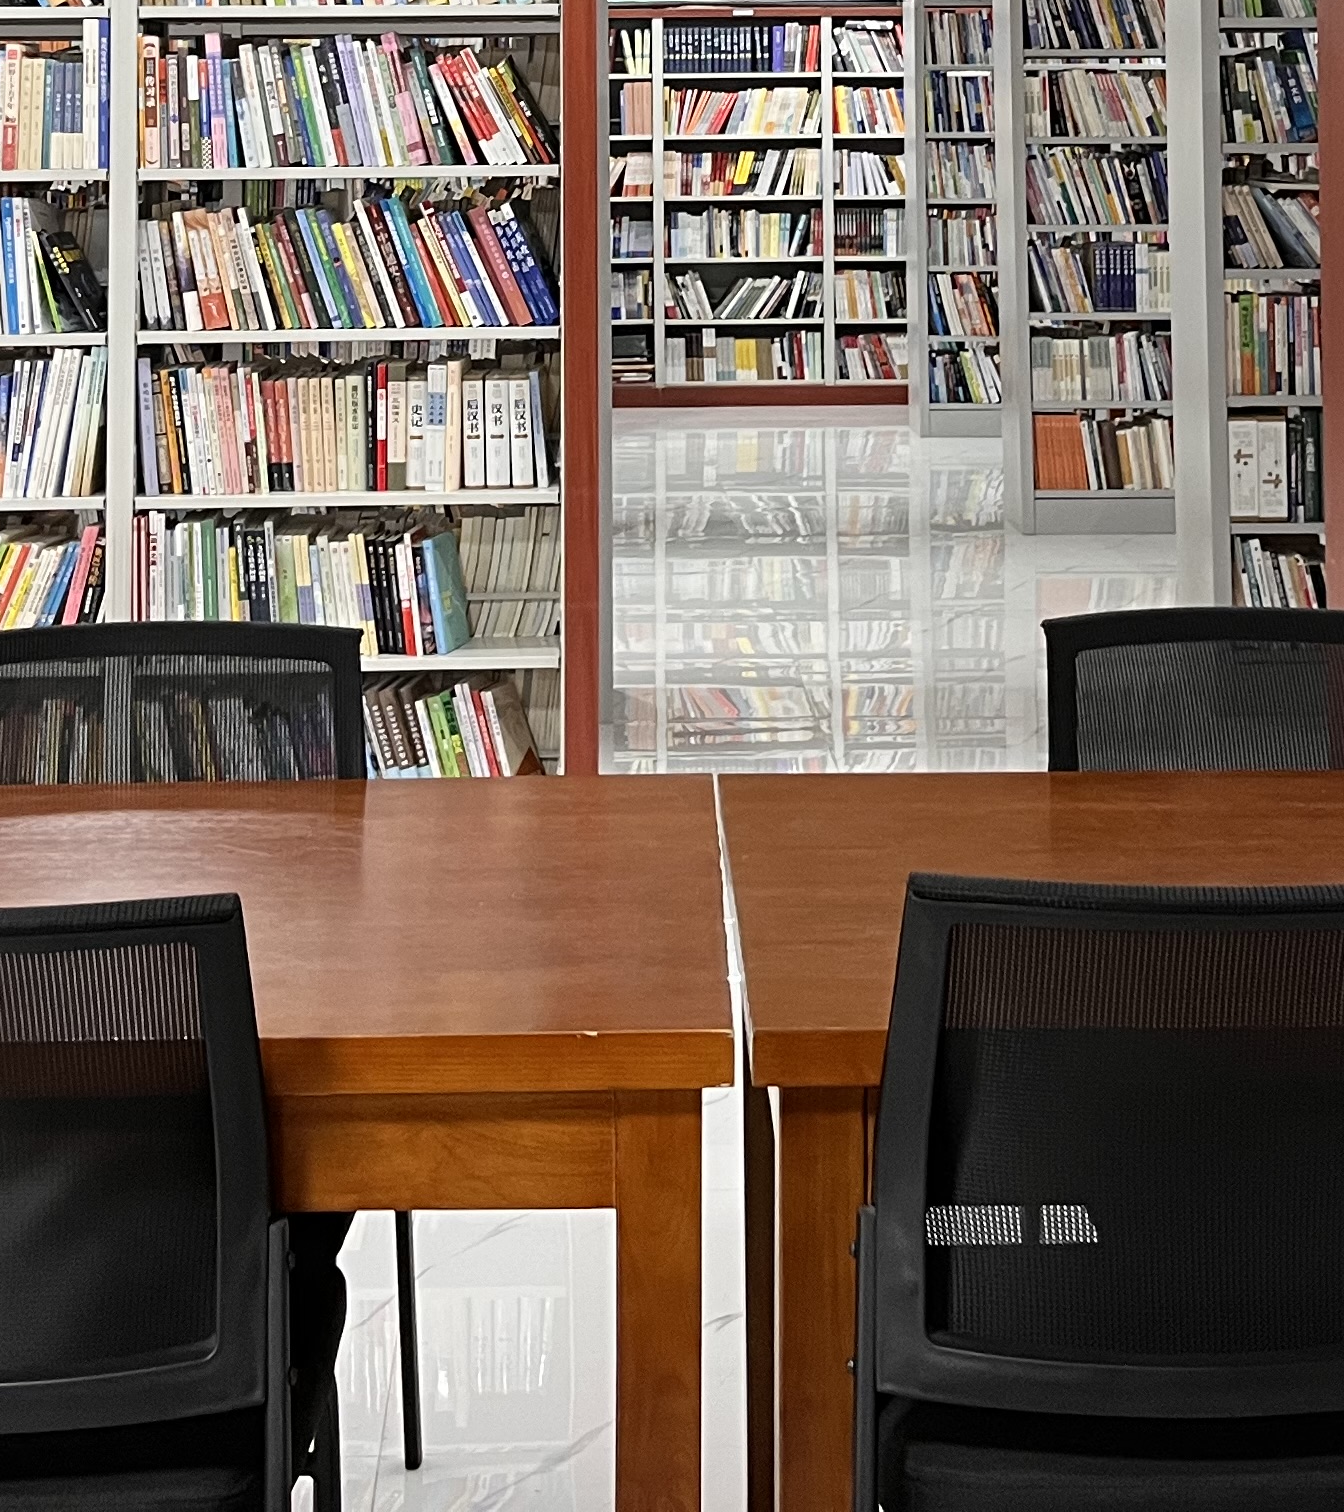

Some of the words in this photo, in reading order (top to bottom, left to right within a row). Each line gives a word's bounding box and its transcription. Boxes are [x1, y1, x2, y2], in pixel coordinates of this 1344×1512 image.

[411, 404, 423, 427] 史记
[467, 399, 479, 434] 后汉书
[491, 403, 503, 426] 汉书
[514, 399, 526, 434] 后汉书
